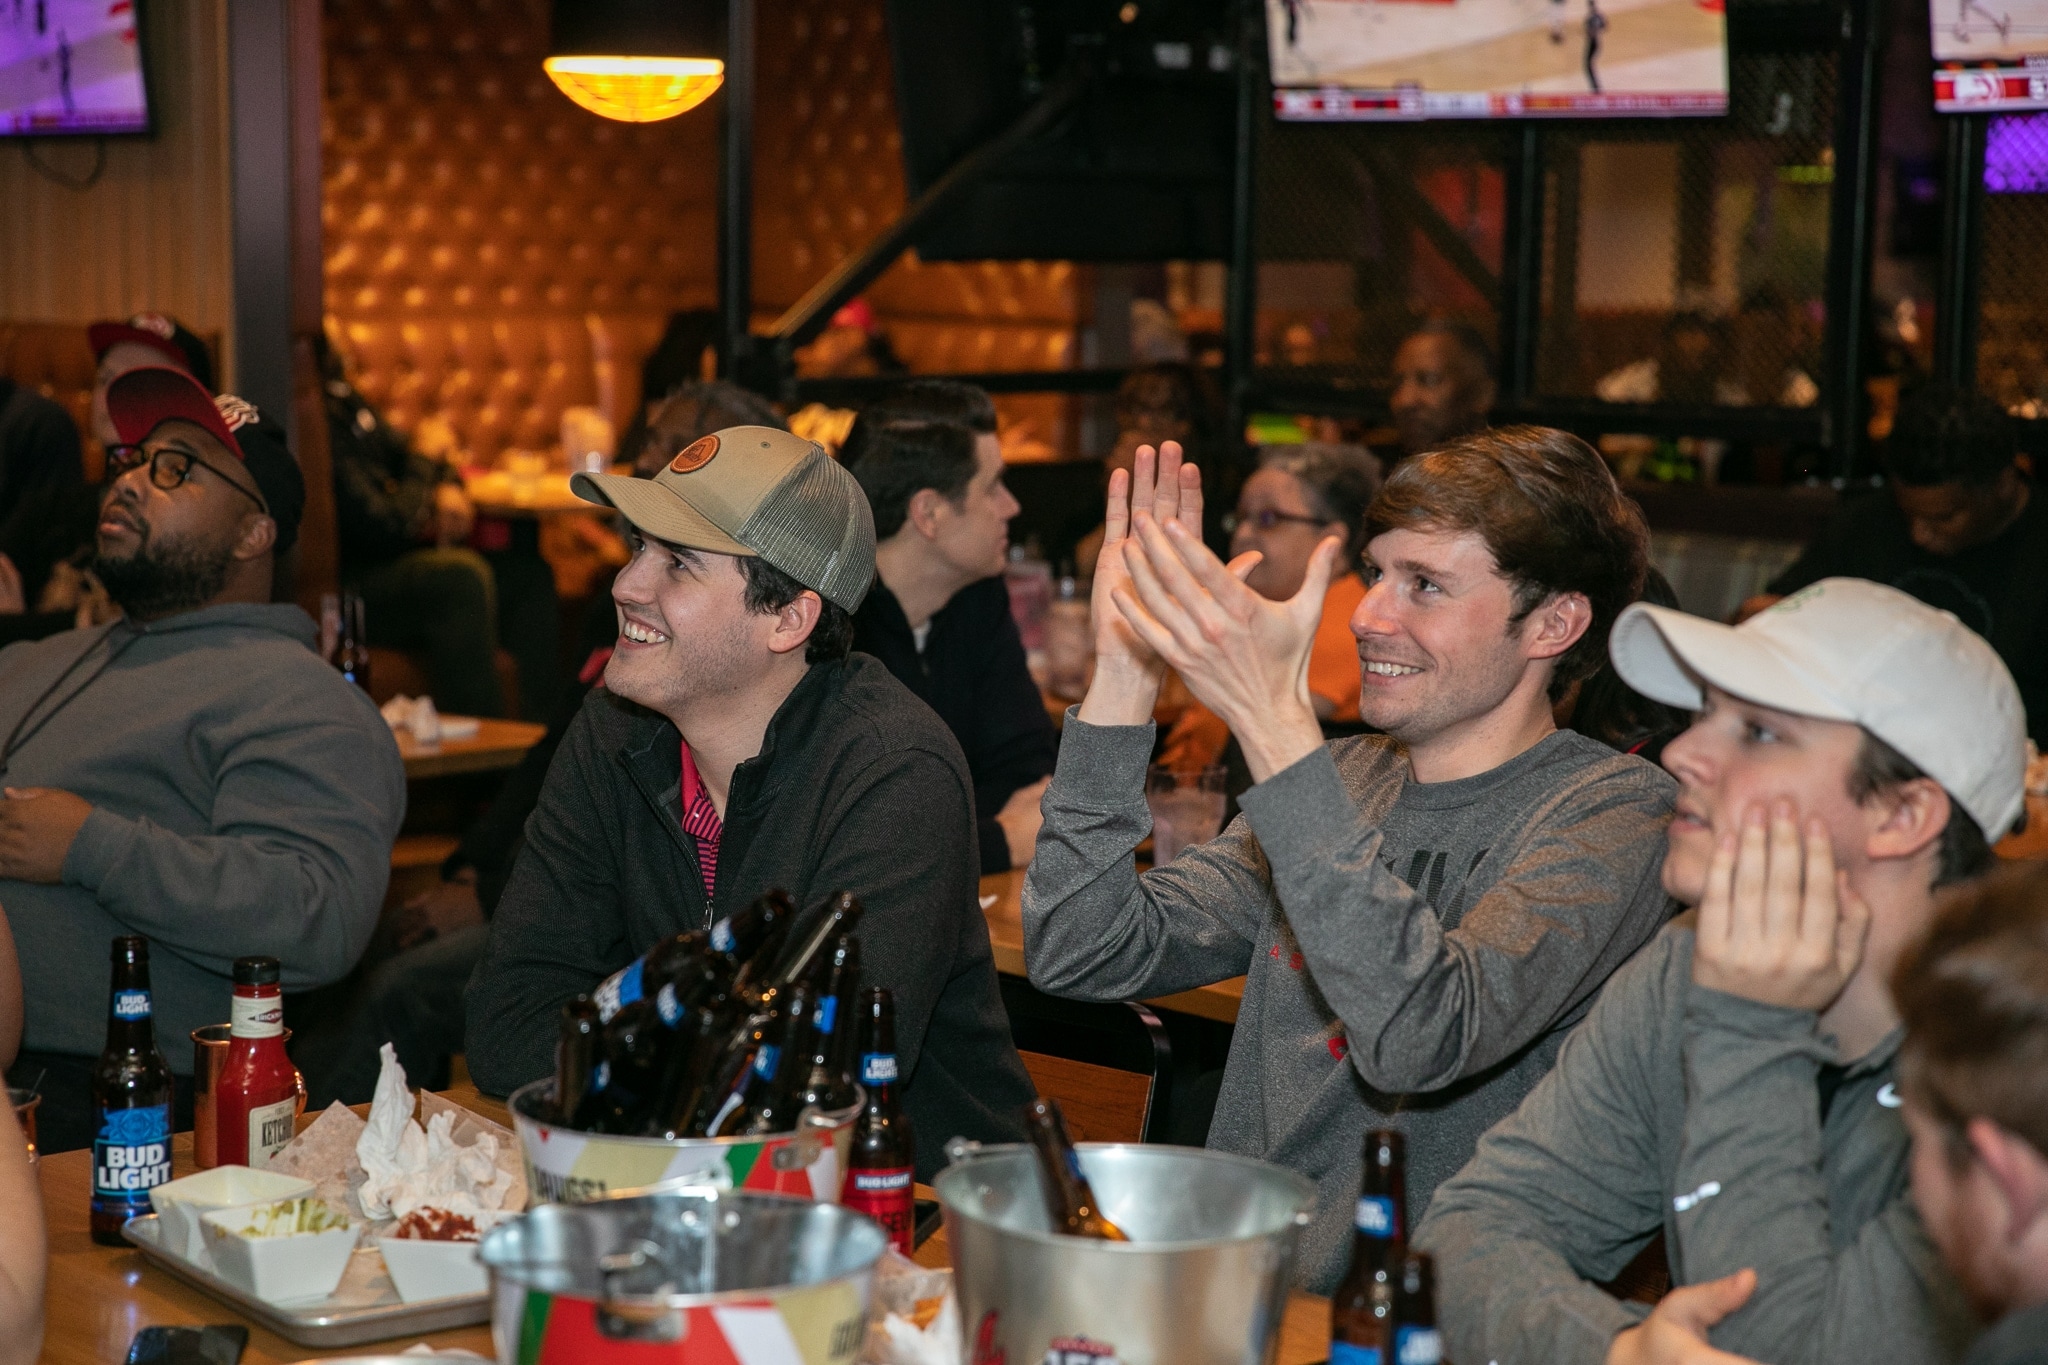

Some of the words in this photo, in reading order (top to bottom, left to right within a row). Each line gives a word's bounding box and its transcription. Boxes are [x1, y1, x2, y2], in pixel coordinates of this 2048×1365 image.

[116, 1002, 150, 1014] LIGHT
[120, 994, 146, 1004] BUD
[106, 1143, 165, 1168] BUD
[98, 1160, 171, 1190] LIGHT
